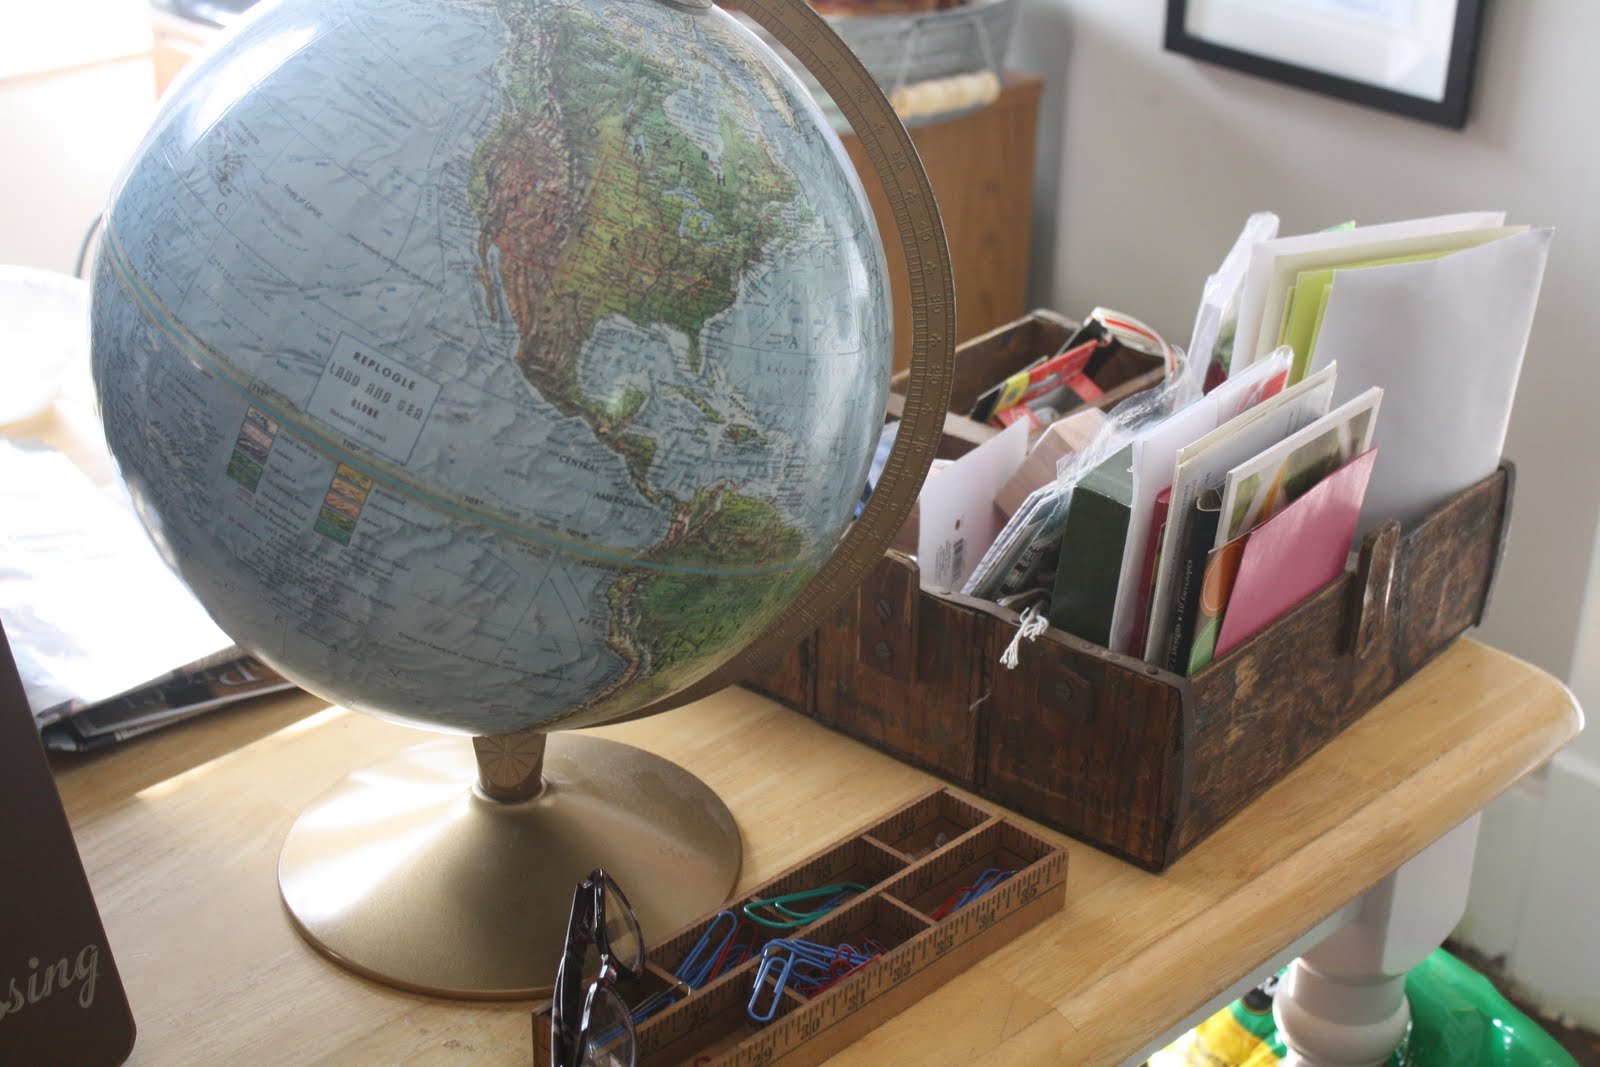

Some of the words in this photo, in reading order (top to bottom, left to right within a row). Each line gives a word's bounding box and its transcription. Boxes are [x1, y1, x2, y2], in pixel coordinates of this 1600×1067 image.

[329, 361, 361, 387] LAND
[365, 381, 393, 404] AND
[396, 399, 424, 421] SEA
[353, 351, 417, 392] REPLOGLE
[350, 398, 380, 419] GLOBE
[559, 455, 600, 474] CENTRAL
[0, 944, 99, 1020] sing
[799, 1018, 820, 1040] 30
[847, 988, 866, 1007] 31
[892, 960, 912, 982] 32
